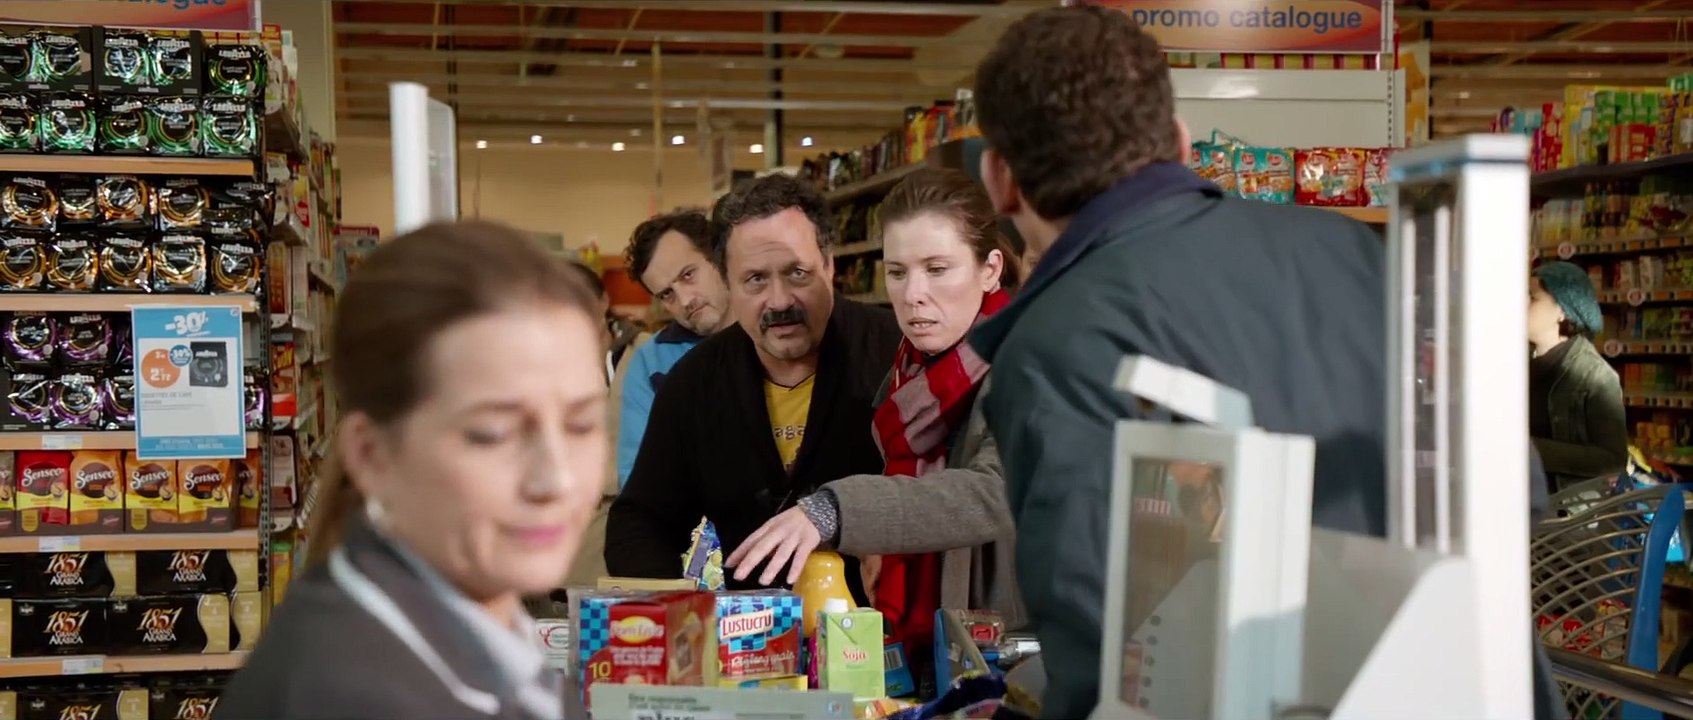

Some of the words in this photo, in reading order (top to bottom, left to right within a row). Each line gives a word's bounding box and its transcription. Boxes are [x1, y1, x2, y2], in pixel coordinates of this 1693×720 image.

[1133, 9, 1219, 28] promo
[1229, 6, 1363, 33] catalogue
[43, 553, 89, 574] 1851
[166, 550, 212, 570] 1851
[43, 610, 90, 634] 1851
[136, 607, 183, 631] 1851
[722, 610, 772, 636] Lustucru
[843, 650, 866, 664] Soja
[589, 662, 611, 679] 10
[172, 697, 219, 720] 1851
